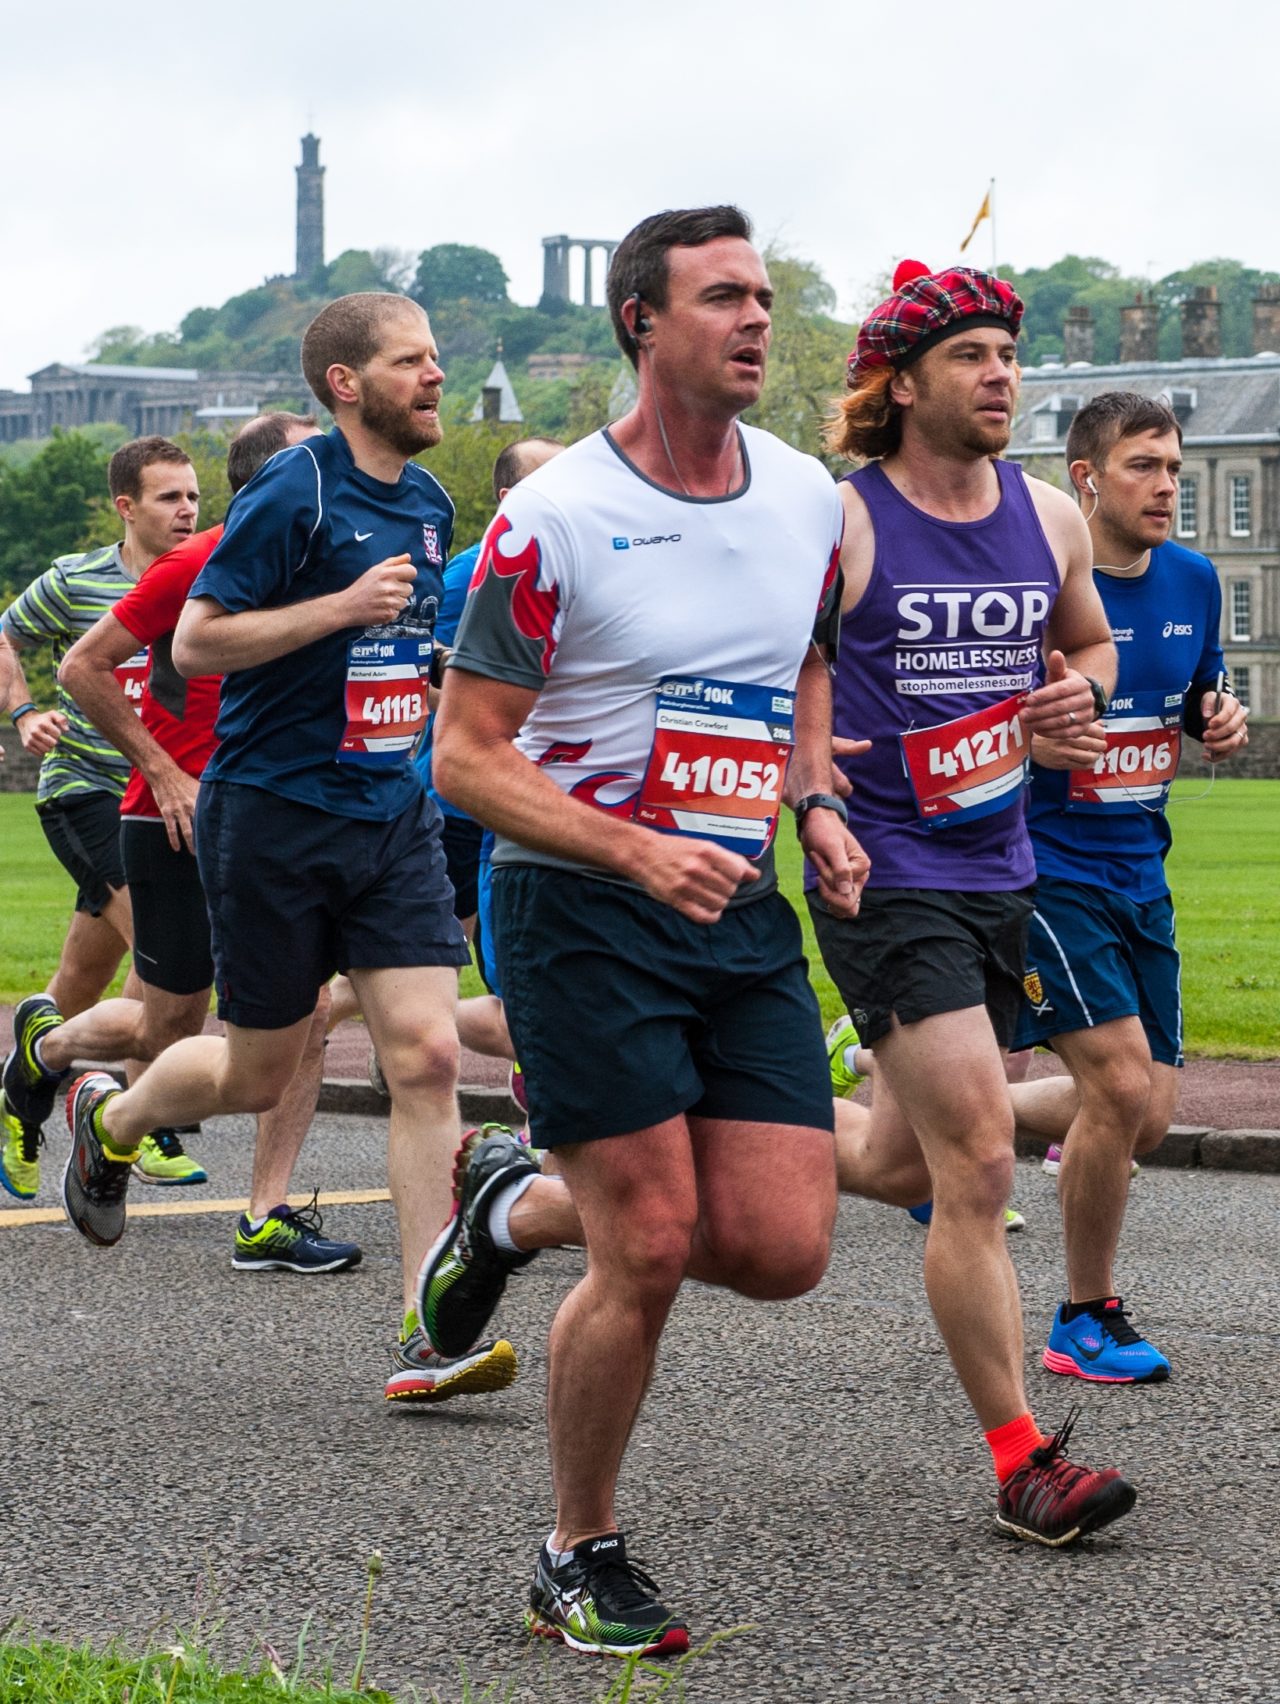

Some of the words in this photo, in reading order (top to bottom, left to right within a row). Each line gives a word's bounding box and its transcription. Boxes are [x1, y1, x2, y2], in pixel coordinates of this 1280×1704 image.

[897, 590, 1050, 641] STOP
[380, 644, 395, 658] 10K
[895, 646, 1038, 671] HOMELESSNESS
[362, 693, 422, 725] 41113
[704, 686, 734, 705] 10K
[1111, 698, 1134, 711] 10K
[928, 714, 1024, 778] 41271
[660, 751, 780, 802] 41052
